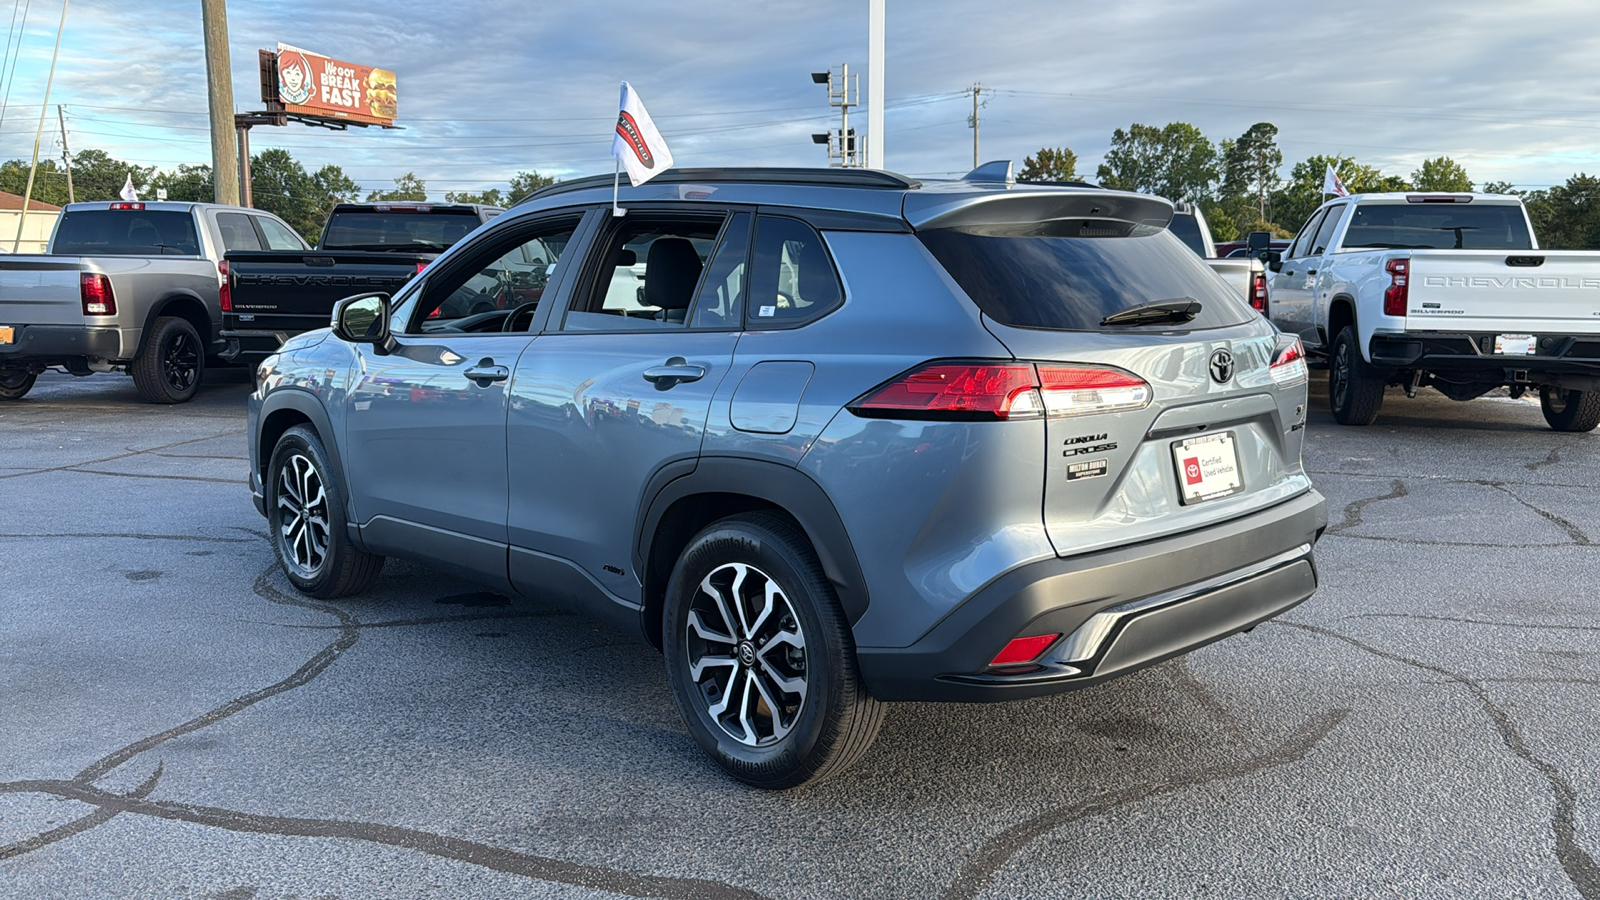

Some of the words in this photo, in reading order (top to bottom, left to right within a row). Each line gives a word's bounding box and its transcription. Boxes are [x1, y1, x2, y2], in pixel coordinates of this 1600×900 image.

[324, 60, 337, 75] We
[337, 67, 355, 79] GOT
[320, 73, 360, 91] BREAK
[321, 86, 361, 108] FAST
[618, 115, 649, 161] CERTIFIED
[240, 275, 402, 287] CHEVROLET
[1063, 433, 1108, 445] COROLLA
[1063, 442, 1118, 457] CROSS
[1201, 456, 1222, 467] Certified
[1203, 468, 1217, 477] Used
[1217, 465, 1234, 475] Vehicles
